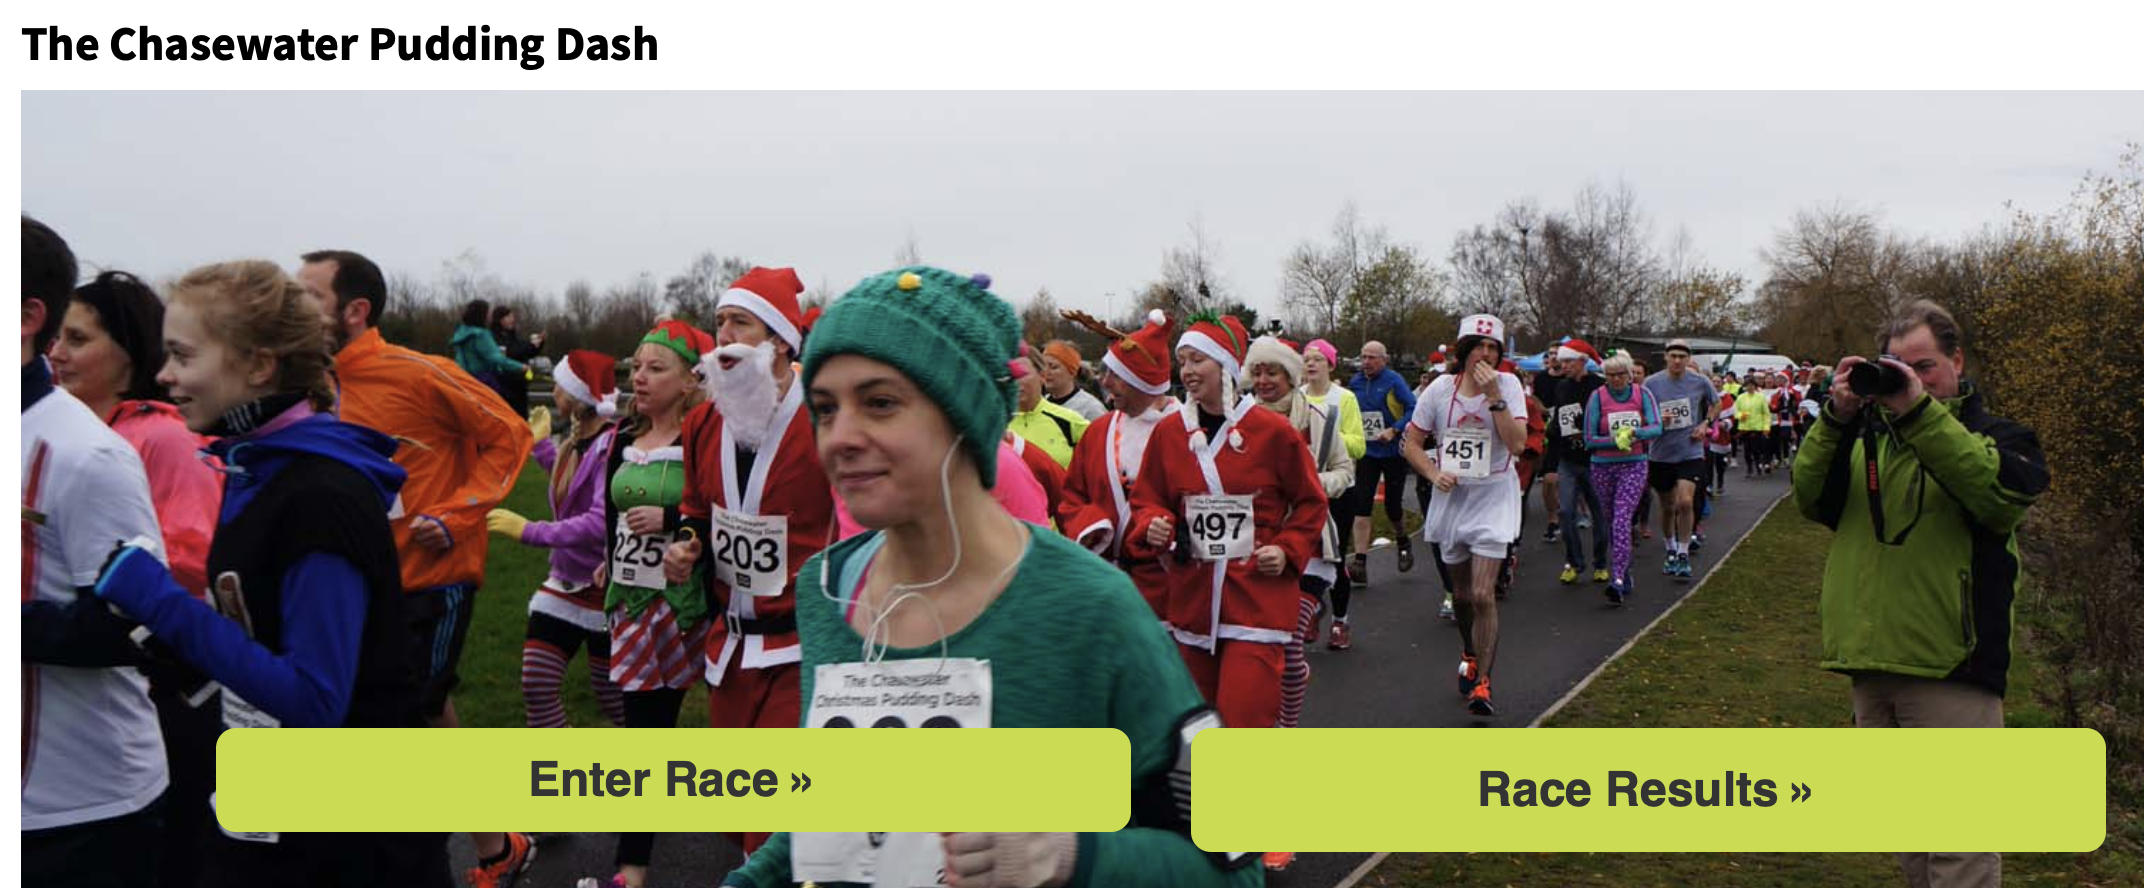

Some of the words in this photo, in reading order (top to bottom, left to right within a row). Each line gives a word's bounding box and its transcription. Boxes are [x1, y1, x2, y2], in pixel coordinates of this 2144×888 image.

[1445, 440, 1484, 460] 451
[1192, 512, 1247, 541] 497
[615, 531, 666, 568] 225
[716, 529, 780, 573] 203
[881, 691, 939, 709] Pudding
